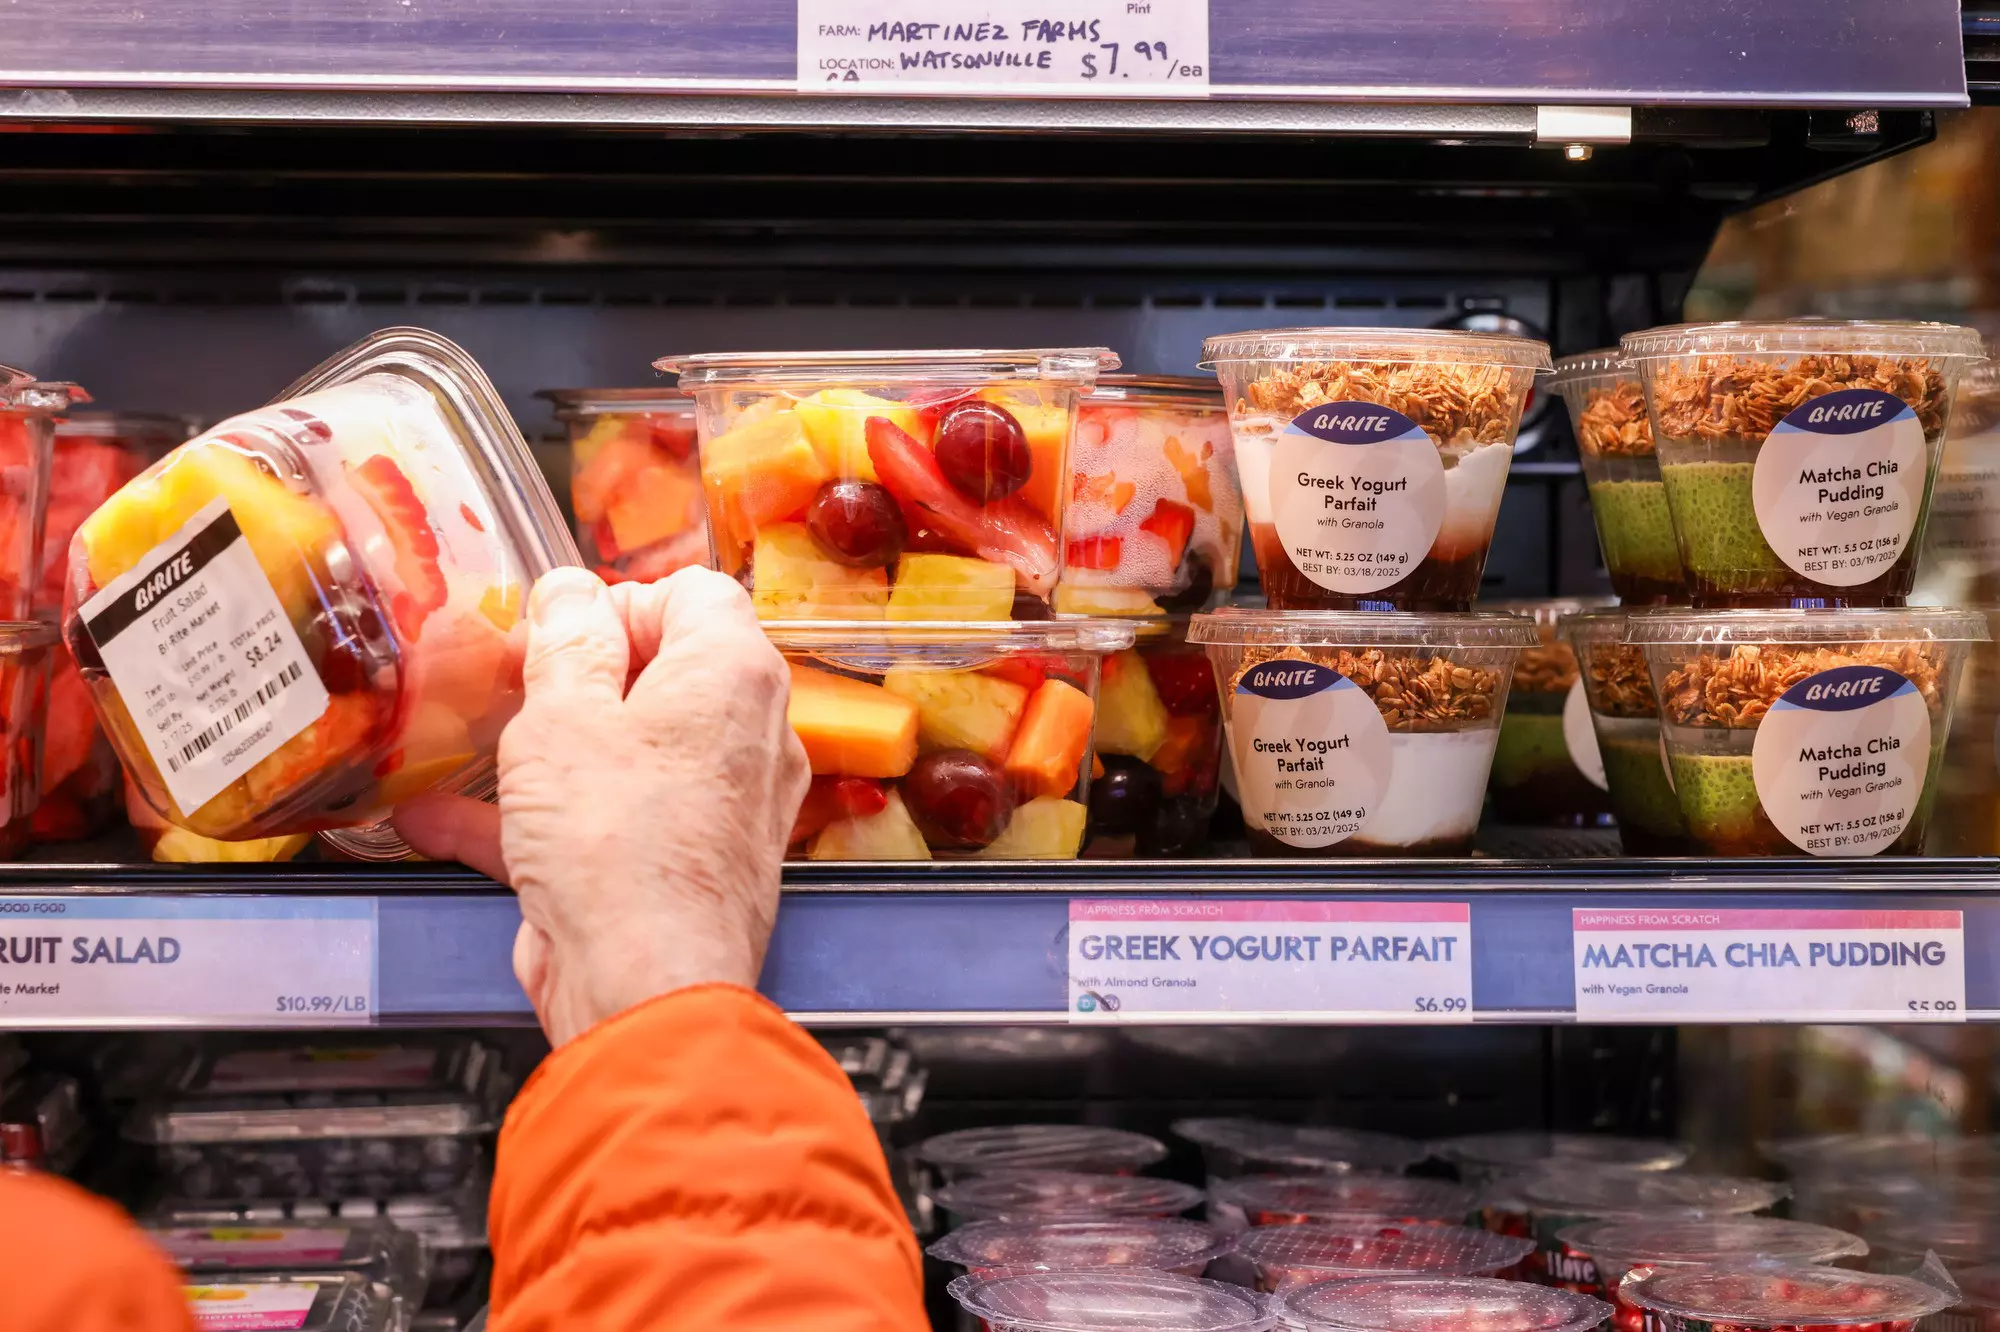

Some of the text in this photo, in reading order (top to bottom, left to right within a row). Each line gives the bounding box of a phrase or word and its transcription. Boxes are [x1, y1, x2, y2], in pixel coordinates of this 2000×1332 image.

[1127, 3, 1151, 14] Pint
[818, 19, 1101, 42] FARM: MARTINEZ FARMS
[818, 51, 1052, 71] LOCATION: WATSONVILLE
[1799, 460, 1899, 484] Matcha Chia
[1297, 472, 1407, 494] Greek Yogurt
[1324, 495, 1377, 511] Parfait
[1818, 485, 1884, 503] Pudding
[1800, 501, 1899, 523] with Vegan Granola
[1317, 517, 1384, 530] with Granola
[1798, 533, 1900, 557] NET WT: 5.5 OZ (156 g)
[1296, 548, 1409, 564] NET WT: 5.25 OZ (149 g)
[1804, 550, 1897, 572] BEST BY: 03/19/2025
[1302, 562, 1400, 577] BEST BY: 03/18/2025
[151, 582, 208, 634] Fruit Salad
[158, 602, 221, 656] Bi-Rite Market
[229, 610, 278, 650] TOTAL PRICE
[195, 641, 219, 663] Price
[246, 630, 284, 670] $8.24
[196, 670, 236, 703] Net Weight
[156, 710, 184, 734] Sell By
[1253, 734, 1350, 754] Greek Yogurt
[1799, 736, 1901, 763] Matcha Chia
[1277, 757, 1324, 772] Parfait
[1818, 762, 1886, 781] Pudding
[1274, 777, 1335, 790] with Granola
[1800, 777, 1902, 801] with Vegan Granola
[1263, 806, 1366, 822] NET WT: 5.25 OZ (149 g)
[1800, 808, 1905, 835] NET WT: 5.5 OZ (156 g)
[1271, 822, 1360, 836] BEST BY: 03/21/2025
[1807, 824, 1901, 849] BEST BY: 03/19/2025
[33, 903, 67, 914] FOOD
[1138, 904, 1171, 916] FROM
[1173, 904, 1224, 916] SCRATCH
[1580, 914, 1720, 925] HAPPINESS FROM SCRATCH
[71, 936, 181, 964] SALAD
[1078, 935, 1458, 962] GREEK YOGURT PARFAIT
[1582, 941, 1946, 968] MATCHA CHIA PUDDING
[15, 982, 60, 995] Market
[1077, 975, 1197, 987] with Almond Granola
[1582, 983, 1689, 996] with Vegan Granola
[276, 996, 366, 1012] $10.99/LB
[1414, 996, 1467, 1012] $6.99
[1555, 1253, 1595, 1284] Love
